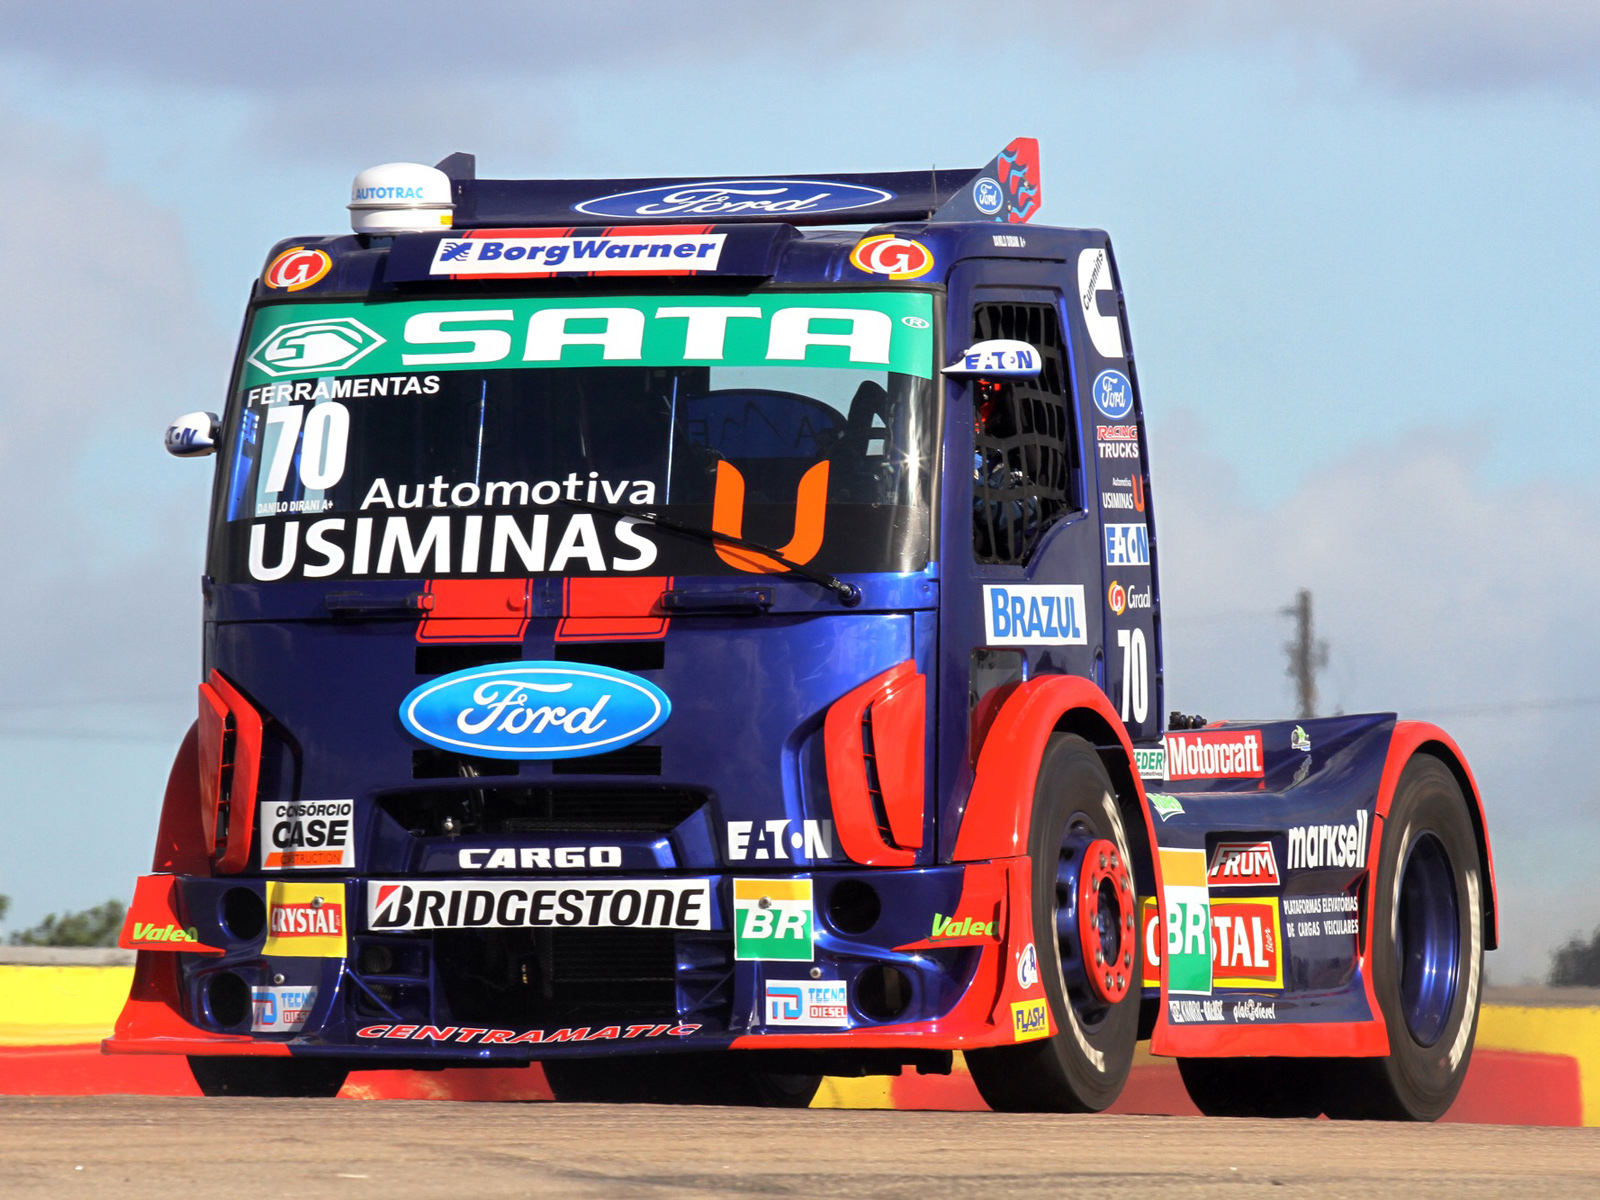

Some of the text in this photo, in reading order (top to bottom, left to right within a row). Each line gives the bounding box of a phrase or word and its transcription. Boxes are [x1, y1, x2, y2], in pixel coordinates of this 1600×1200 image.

[355, 187, 424, 199] AUTOTRAC
[635, 187, 832, 215] Ford
[979, 184, 997, 206] Ford
[477, 240, 716, 266] BorgWarner
[1083, 250, 1103, 311] Cummins
[402, 308, 890, 366] SATA
[966, 351, 1032, 369] EATON
[248, 375, 440, 407] FERRAMENTAS
[1102, 376, 1126, 408] Ford
[1097, 426, 1137, 440] RACING
[265, 401, 350, 493] 70
[1098, 443, 1138, 458] TRUCKS
[360, 472, 655, 511] Automotiva
[1102, 493, 1133, 509] USIMINAS
[257, 499, 334, 514] DANILO DIRANI A+
[248, 513, 658, 582] USIMINAS
[1106, 526, 1148, 563] EATON
[990, 588, 1080, 638] BRAZUL
[1118, 628, 1148, 723] 70
[458, 680, 611, 735] Ford
[1133, 752, 1163, 770] EDER
[1169, 735, 1262, 775] Motorcraft
[276, 802, 351, 817] CONSÓRCIO
[272, 820, 349, 849] CASE
[727, 819, 832, 860] EATON
[1287, 809, 1368, 869] marksell
[458, 846, 622, 870] CARGO
[1211, 847, 1275, 877] FRUM
[372, 885, 705, 927] BRIDGESTONE
[1283, 893, 1358, 915] PLATAFORMAS ELEVATÓRIAS
[133, 923, 198, 942] Valeo
[271, 907, 338, 933] CRYSTAL
[741, 908, 807, 939] BR
[931, 913, 1000, 937] Valeo
[1167, 902, 1206, 955] BR
[1286, 919, 1358, 937] DE CARGAS VEICULARES
[1146, 915, 1269, 967] CTAL
[1265, 927, 1274, 953] Beer
[808, 988, 845, 1003] TECNO
[811, 1007, 847, 1018] DIESEL
[1016, 1006, 1045, 1032] FLASH
[356, 1024, 703, 1045] CENTRAMATIC
